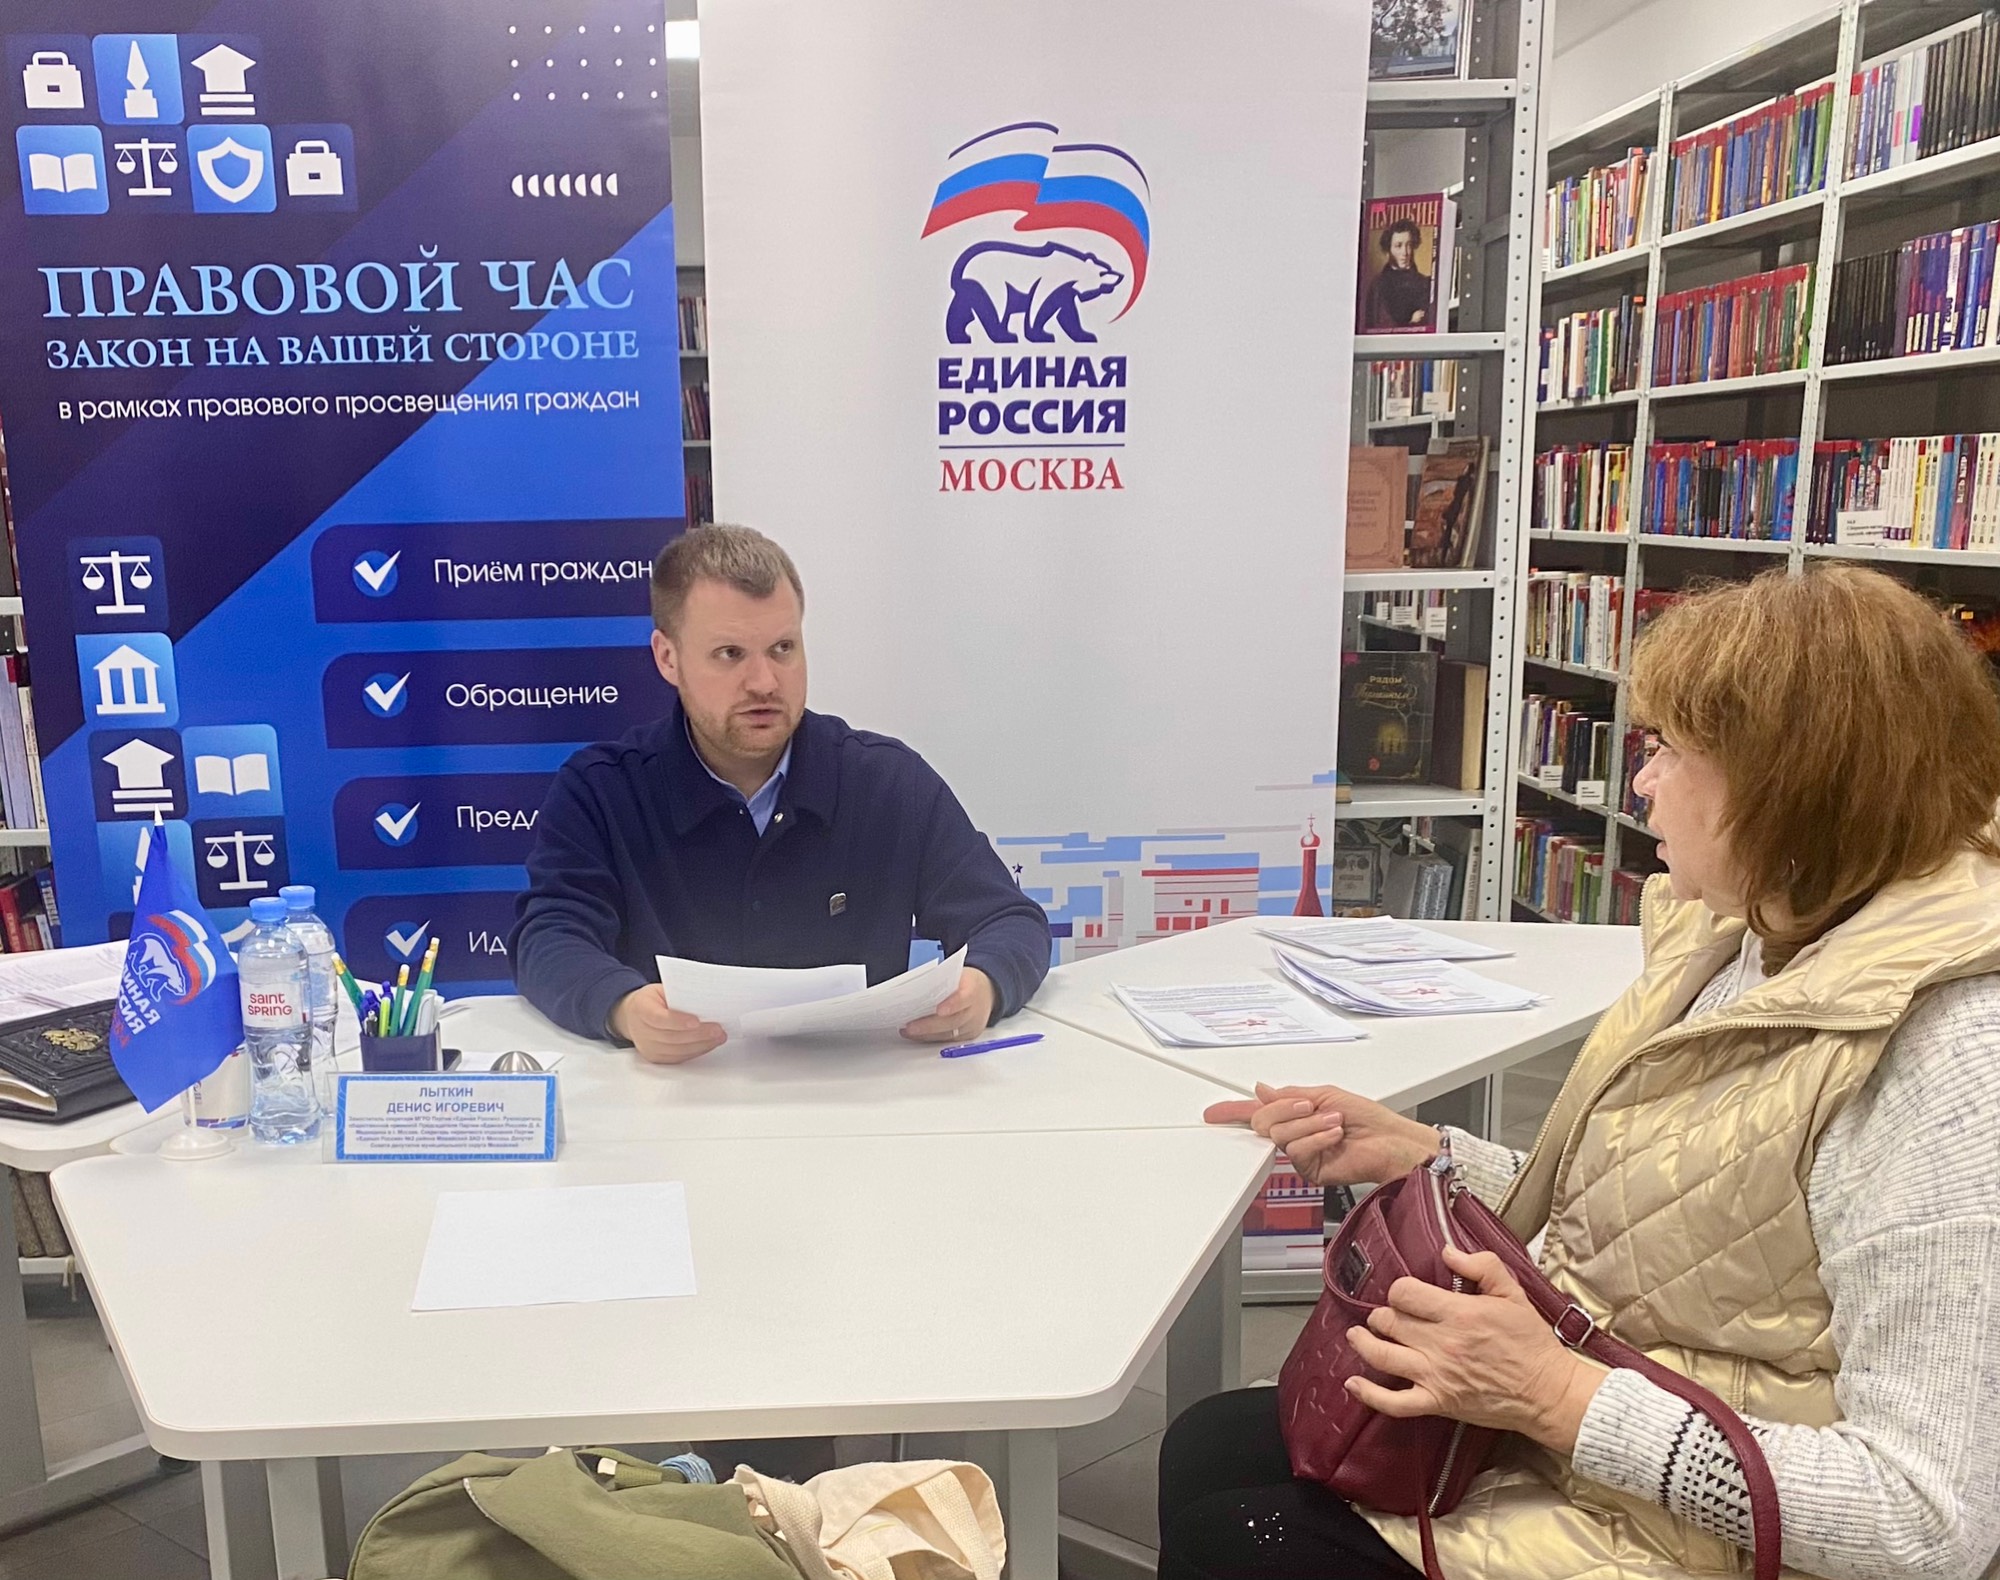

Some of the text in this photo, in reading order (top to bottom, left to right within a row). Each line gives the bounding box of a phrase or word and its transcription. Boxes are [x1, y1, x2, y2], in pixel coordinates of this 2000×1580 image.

[38, 245, 634, 318] ПРАВОВОЙ ЧАС
[46, 325, 640, 369] ЗАКОН НА ВАШЕЙ СТОРОНЕ
[939, 356, 1127, 394] ЕДИНАЯ
[58, 387, 640, 424] в рамках правового просвещения граждан
[939, 399, 1126, 435] РОССИЯ
[939, 457, 1125, 492] МОСКВА
[434, 556, 653, 587] Приём граждан
[445, 682, 619, 711] Обращение
[468, 931, 508, 955] Ид
[386, 1102, 504, 1114] ДЕНИС ИГОРЕВИЧ
[419, 1087, 473, 1098] ЛЫТКИН
